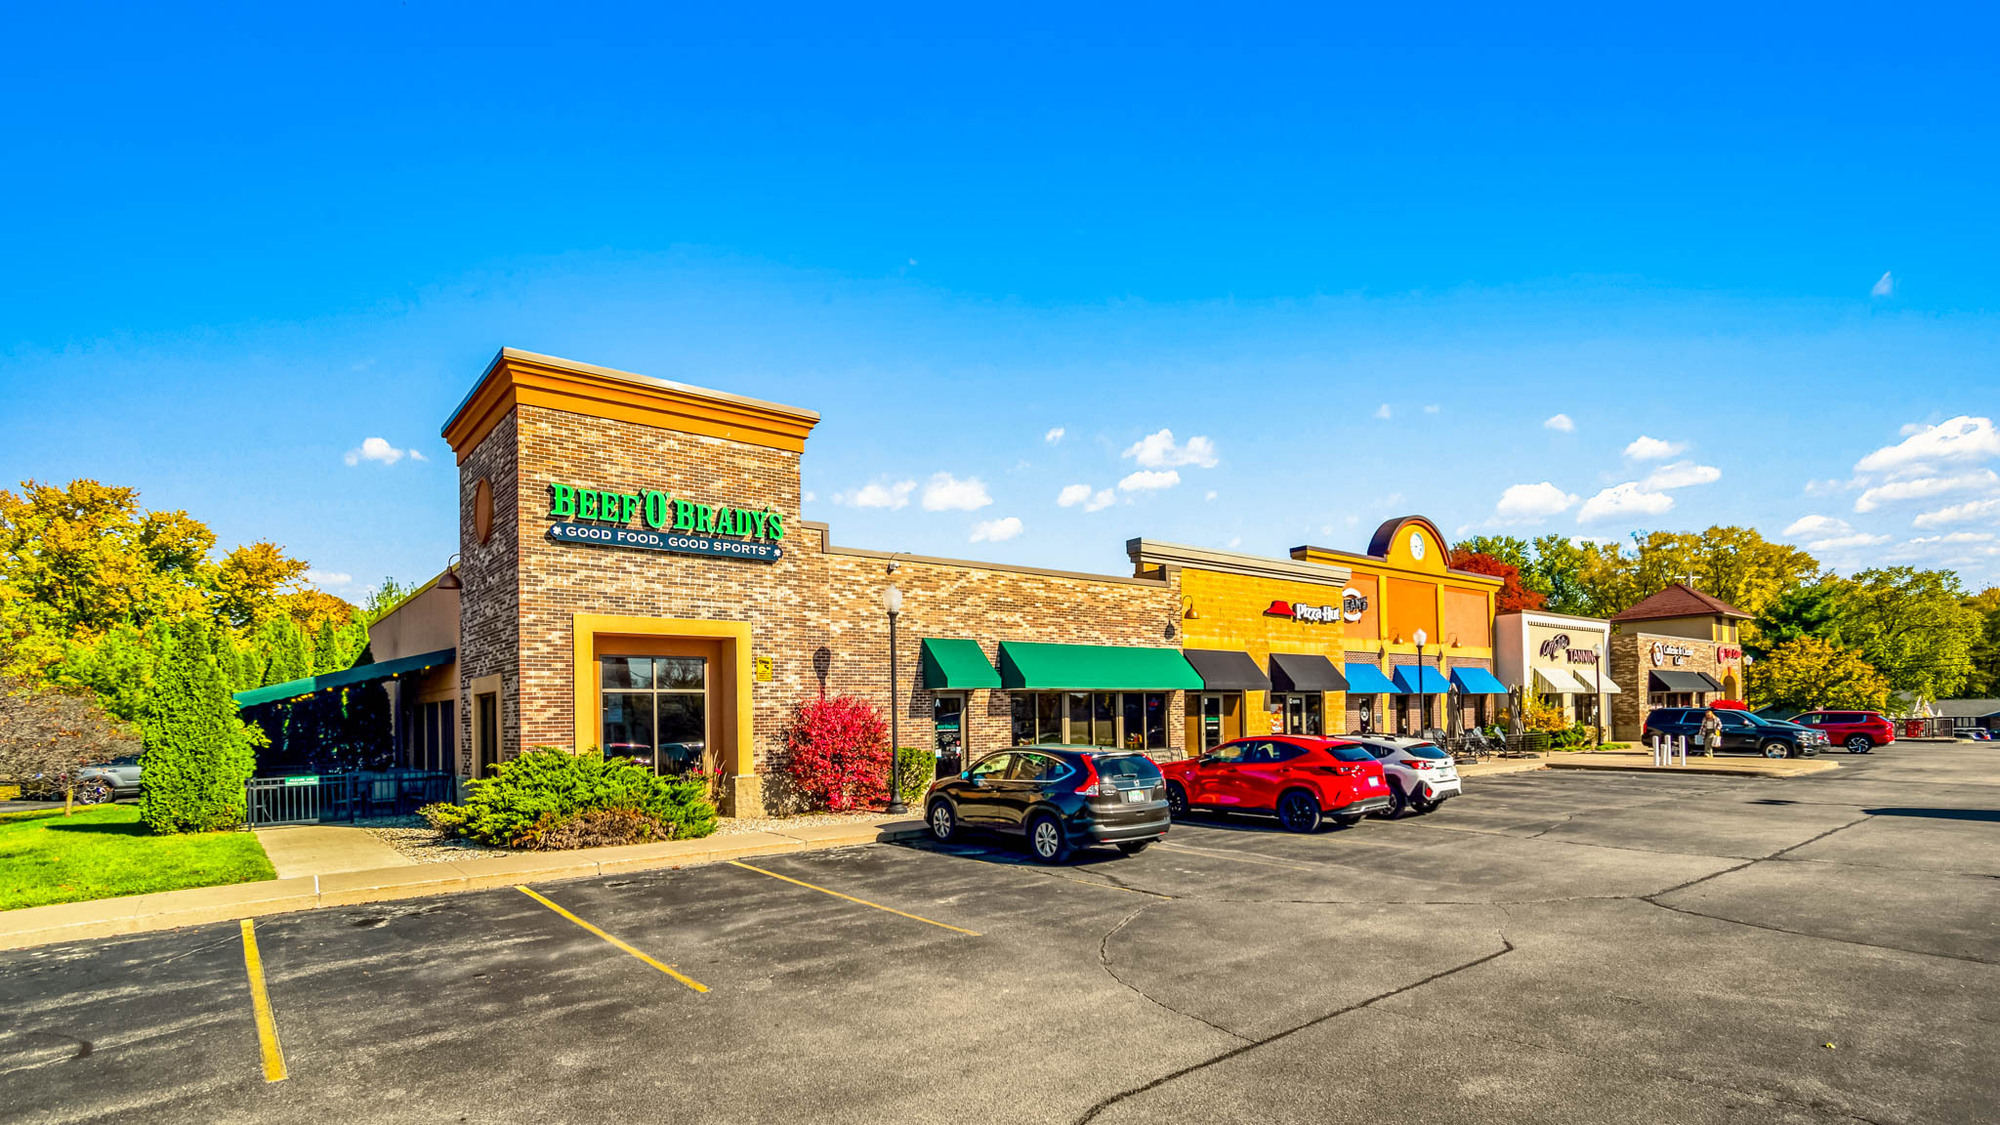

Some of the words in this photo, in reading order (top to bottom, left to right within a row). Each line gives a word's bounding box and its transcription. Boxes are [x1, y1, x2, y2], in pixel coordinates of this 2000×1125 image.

[565, 526, 612, 540] GOOD
[617, 531, 664, 548] FOOD,
[668, 536, 709, 550] GOOD
[1296, 603, 1322, 621] Pizza
[1322, 605, 1341, 621] Hut
